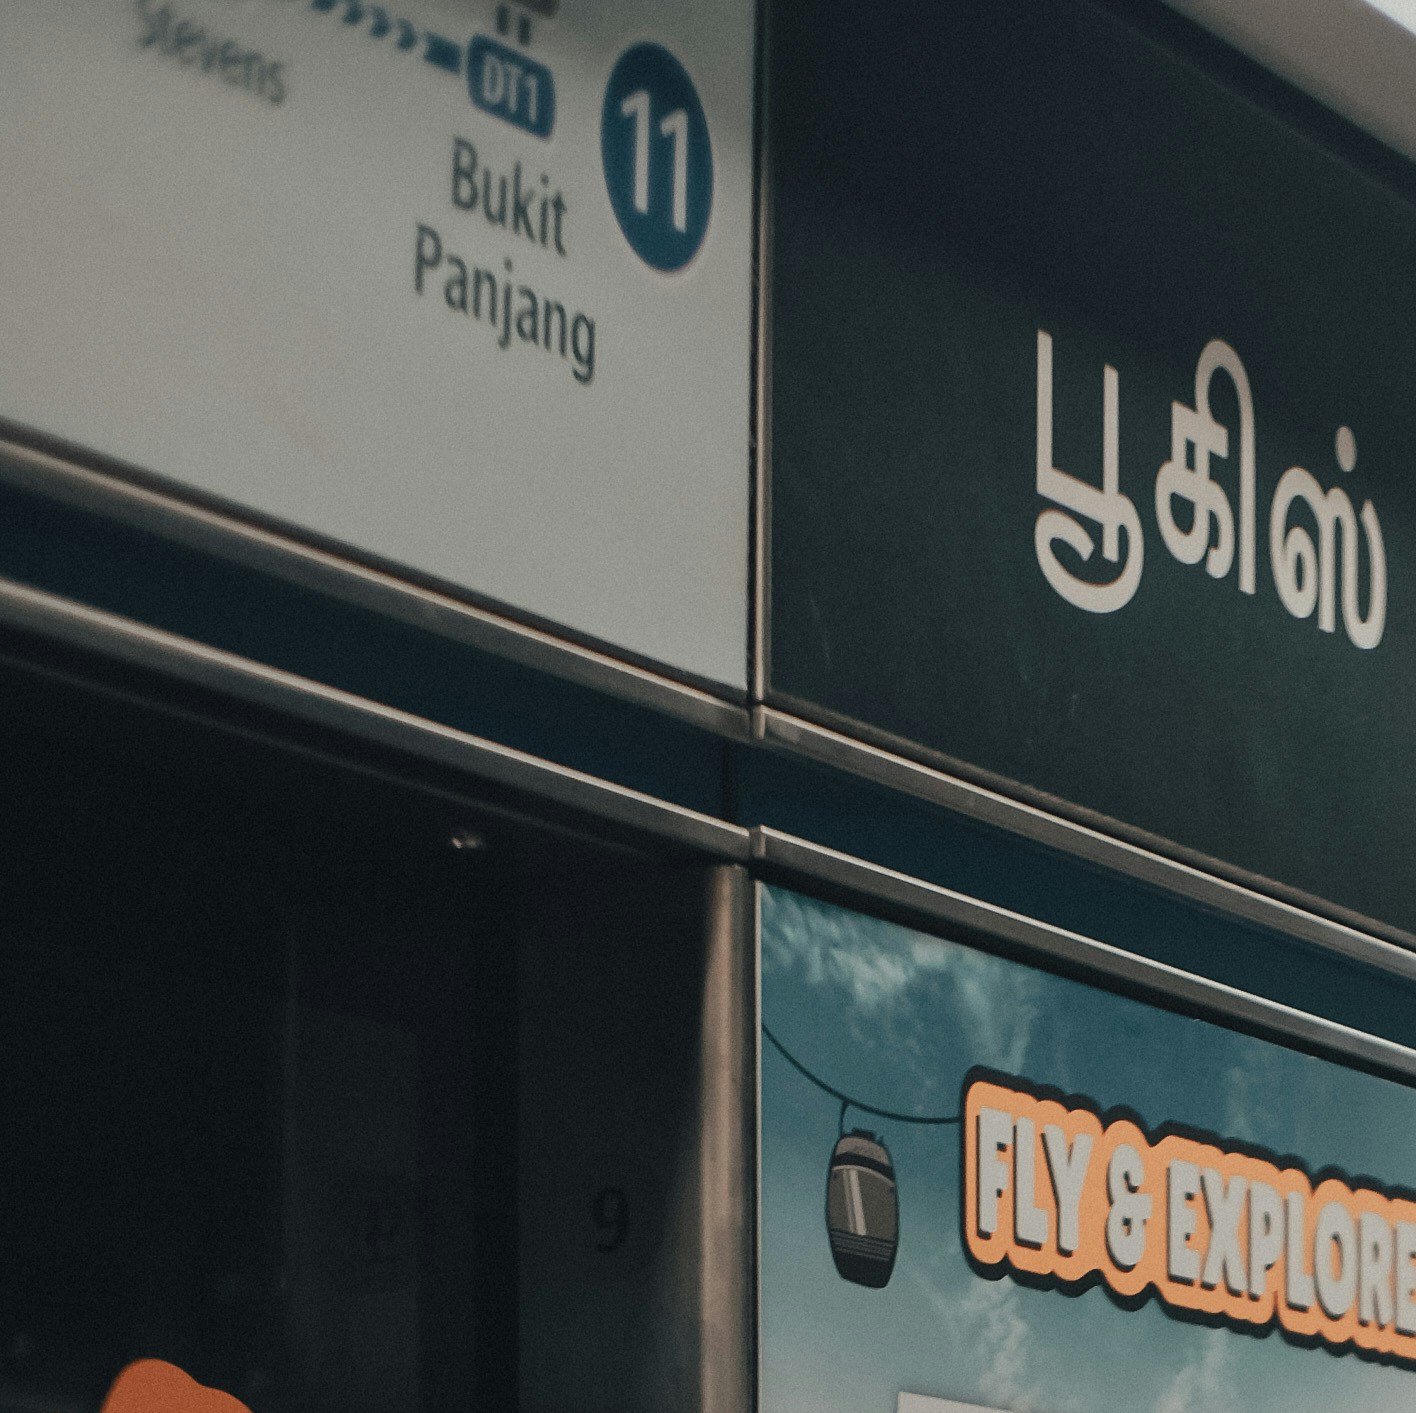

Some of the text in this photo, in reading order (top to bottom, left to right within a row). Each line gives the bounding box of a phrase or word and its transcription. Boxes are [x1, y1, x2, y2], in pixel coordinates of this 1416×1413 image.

[480, 49, 542, 126] DT1
[621, 89, 691, 235] 11
[451, 135, 569, 258] Bukit
[414, 222, 597, 385] Panjang
[1034, 327, 1388, 650] பூகிஸ்
[975, 1104, 1094, 1259] FLY
[1106, 1143, 1154, 1270] &
